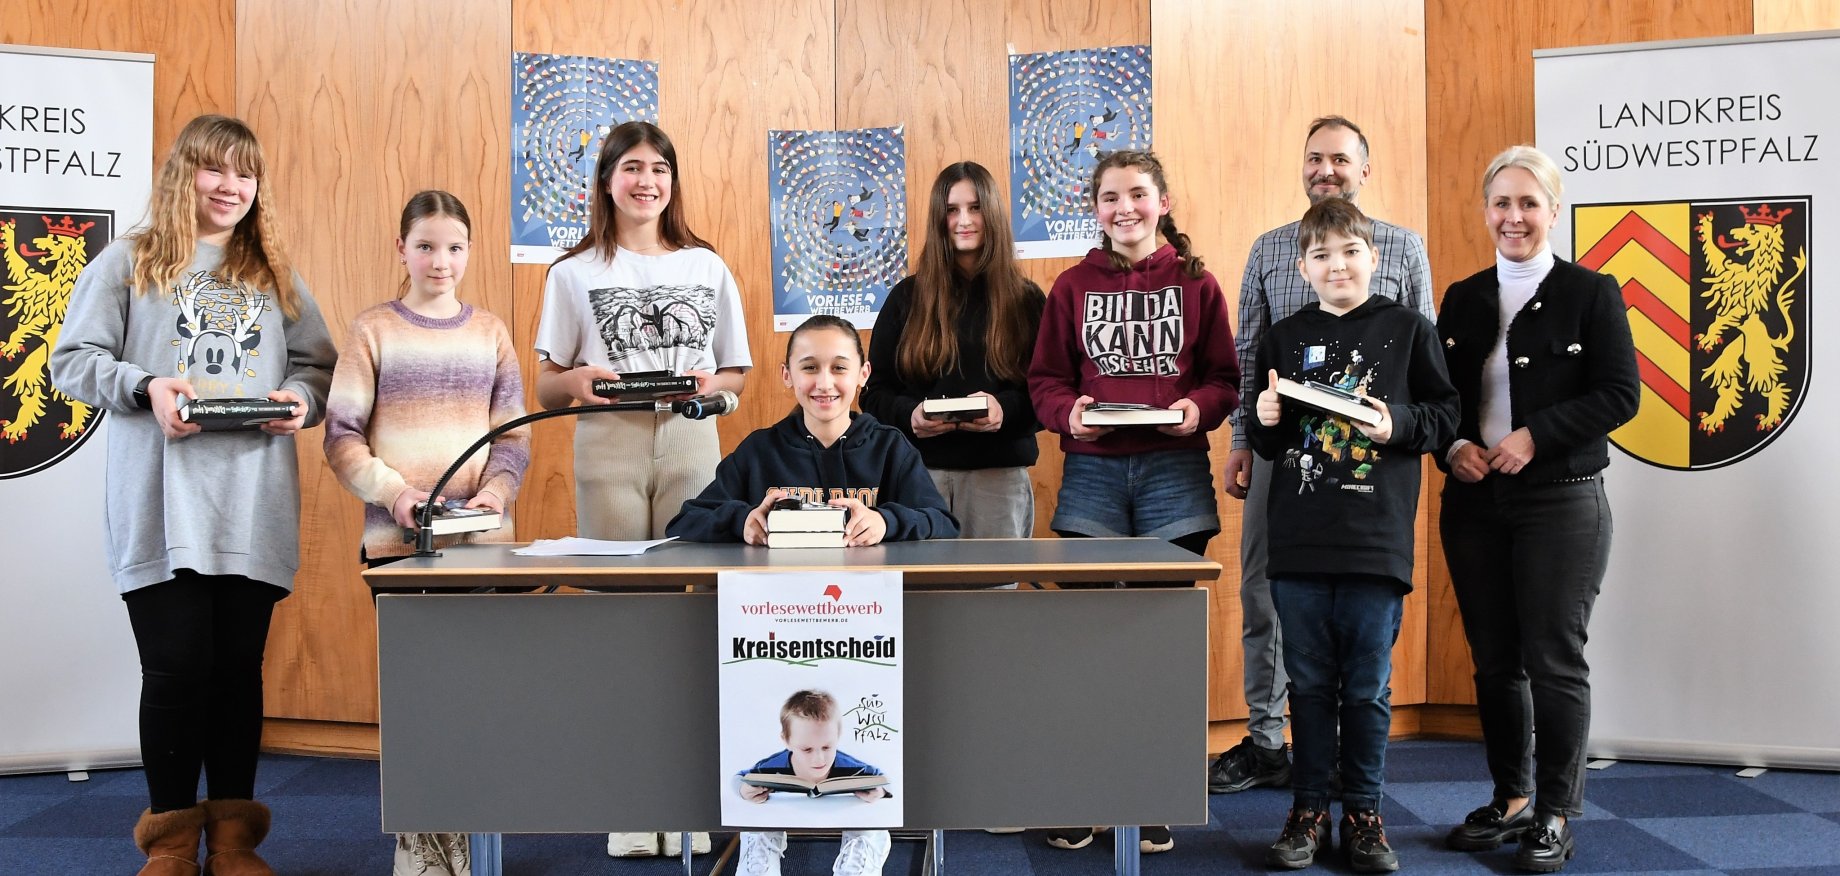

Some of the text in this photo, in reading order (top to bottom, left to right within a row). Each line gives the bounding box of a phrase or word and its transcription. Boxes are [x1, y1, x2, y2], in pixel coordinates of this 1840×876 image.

[0, 104, 86, 135] KREIS
[1599, 93, 1782, 129] LANDKREIS
[0, 147, 121, 178] TPFALZ
[1564, 135, 1818, 172] SÜDWESTPFALZ
[551, 239, 581, 248] WETT
[806, 293, 862, 307] VORLESE
[810, 304, 871, 316] WETTBEWERB
[1086, 289, 1180, 322] BIN DA
[1085, 319, 1180, 356] KANN
[1099, 355, 1178, 375] OSGEHEN
[741, 601, 882, 615] vorlesewettbewerb
[733, 632, 896, 659] Kreisentscheid
